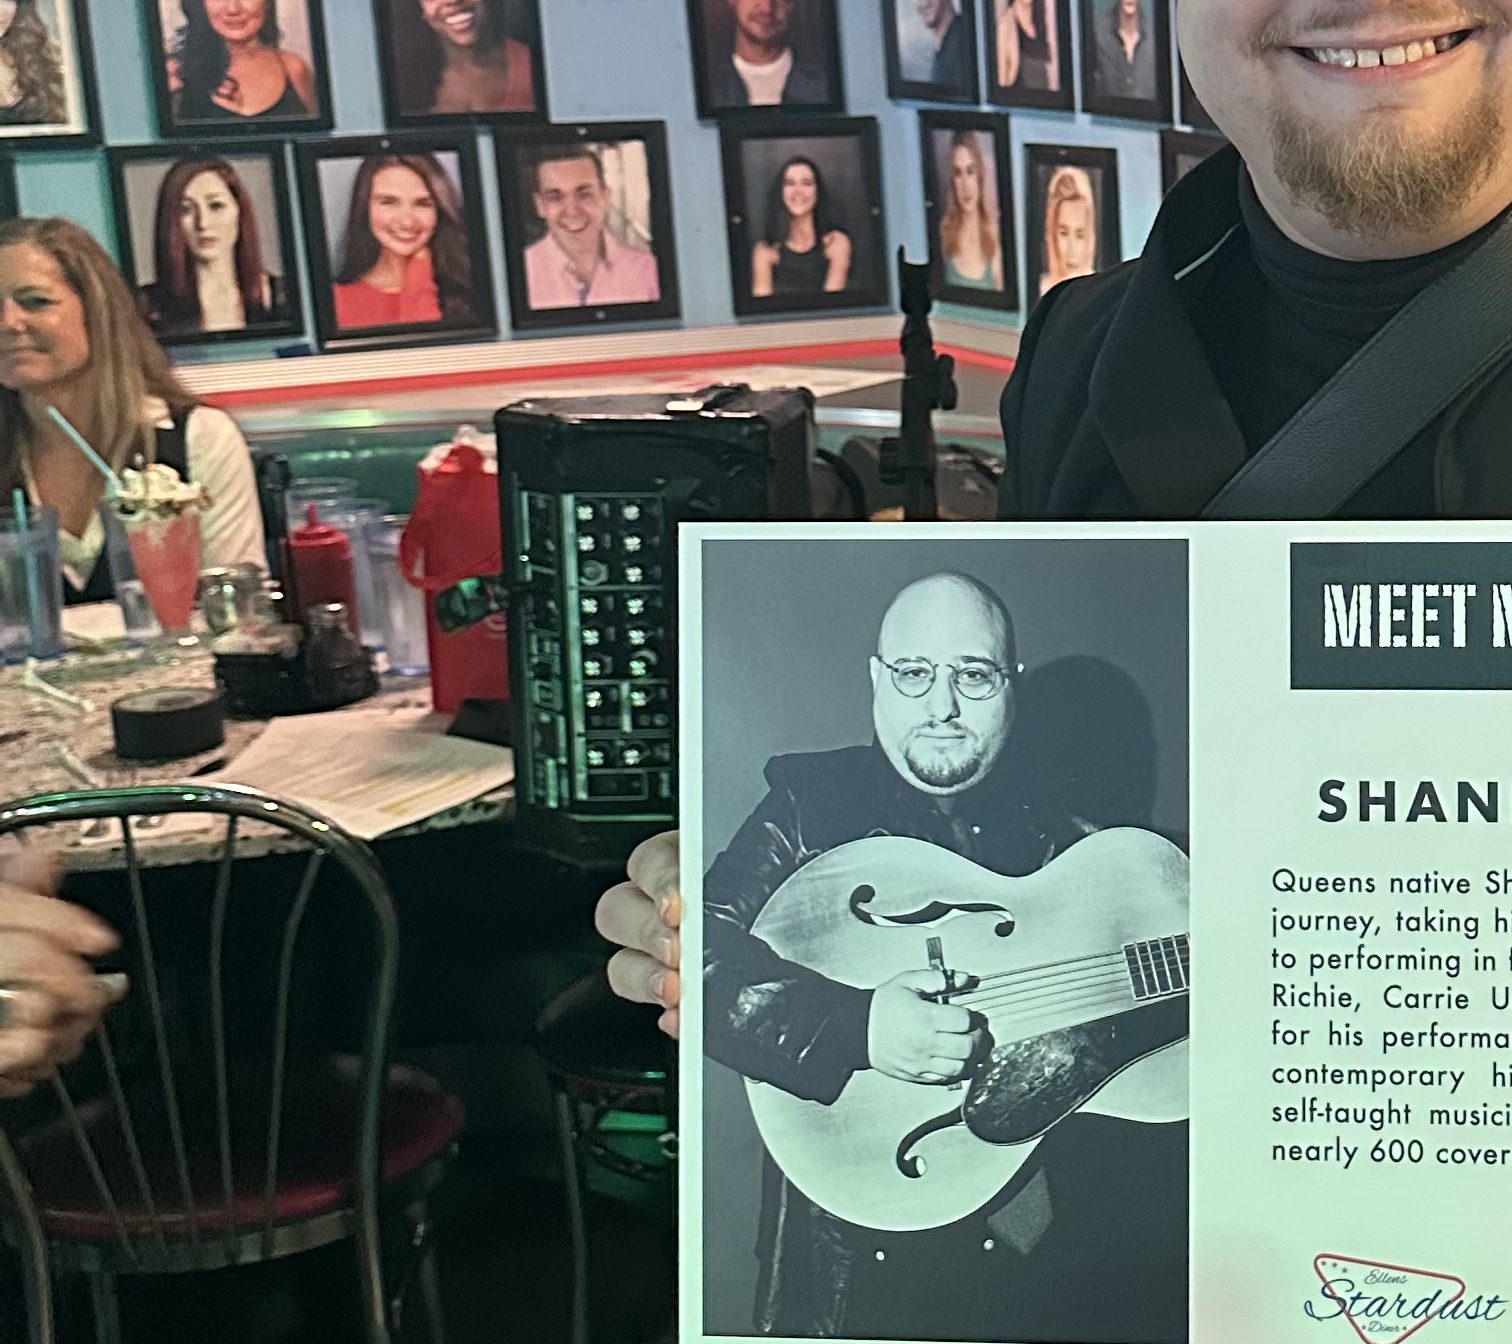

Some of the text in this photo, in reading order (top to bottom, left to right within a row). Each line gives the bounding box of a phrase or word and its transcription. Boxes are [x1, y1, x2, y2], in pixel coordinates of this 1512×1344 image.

[1322, 582, 1477, 649] MEET
[1271, 867, 1376, 894] Queens
[1390, 869, 1471, 895] native
[1271, 906, 1381, 940] journey,
[1395, 905, 1479, 941] taking
[1271, 947, 1297, 970] to
[1309, 943, 1461, 979] performing
[1473, 947, 1497, 972] in
[1272, 981, 1361, 1013] Richie,
[1383, 984, 1469, 1010] Carrie
[1271, 1018, 1311, 1046] for
[1328, 1019, 1364, 1047] his
[1271, 1063, 1466, 1095] contemporary
[1271, 1096, 1412, 1132] self-taught
[1272, 1135, 1359, 1170] nearly
[1369, 1137, 1424, 1164] 600
[1304, 1278, 1510, 1322] Stardust
